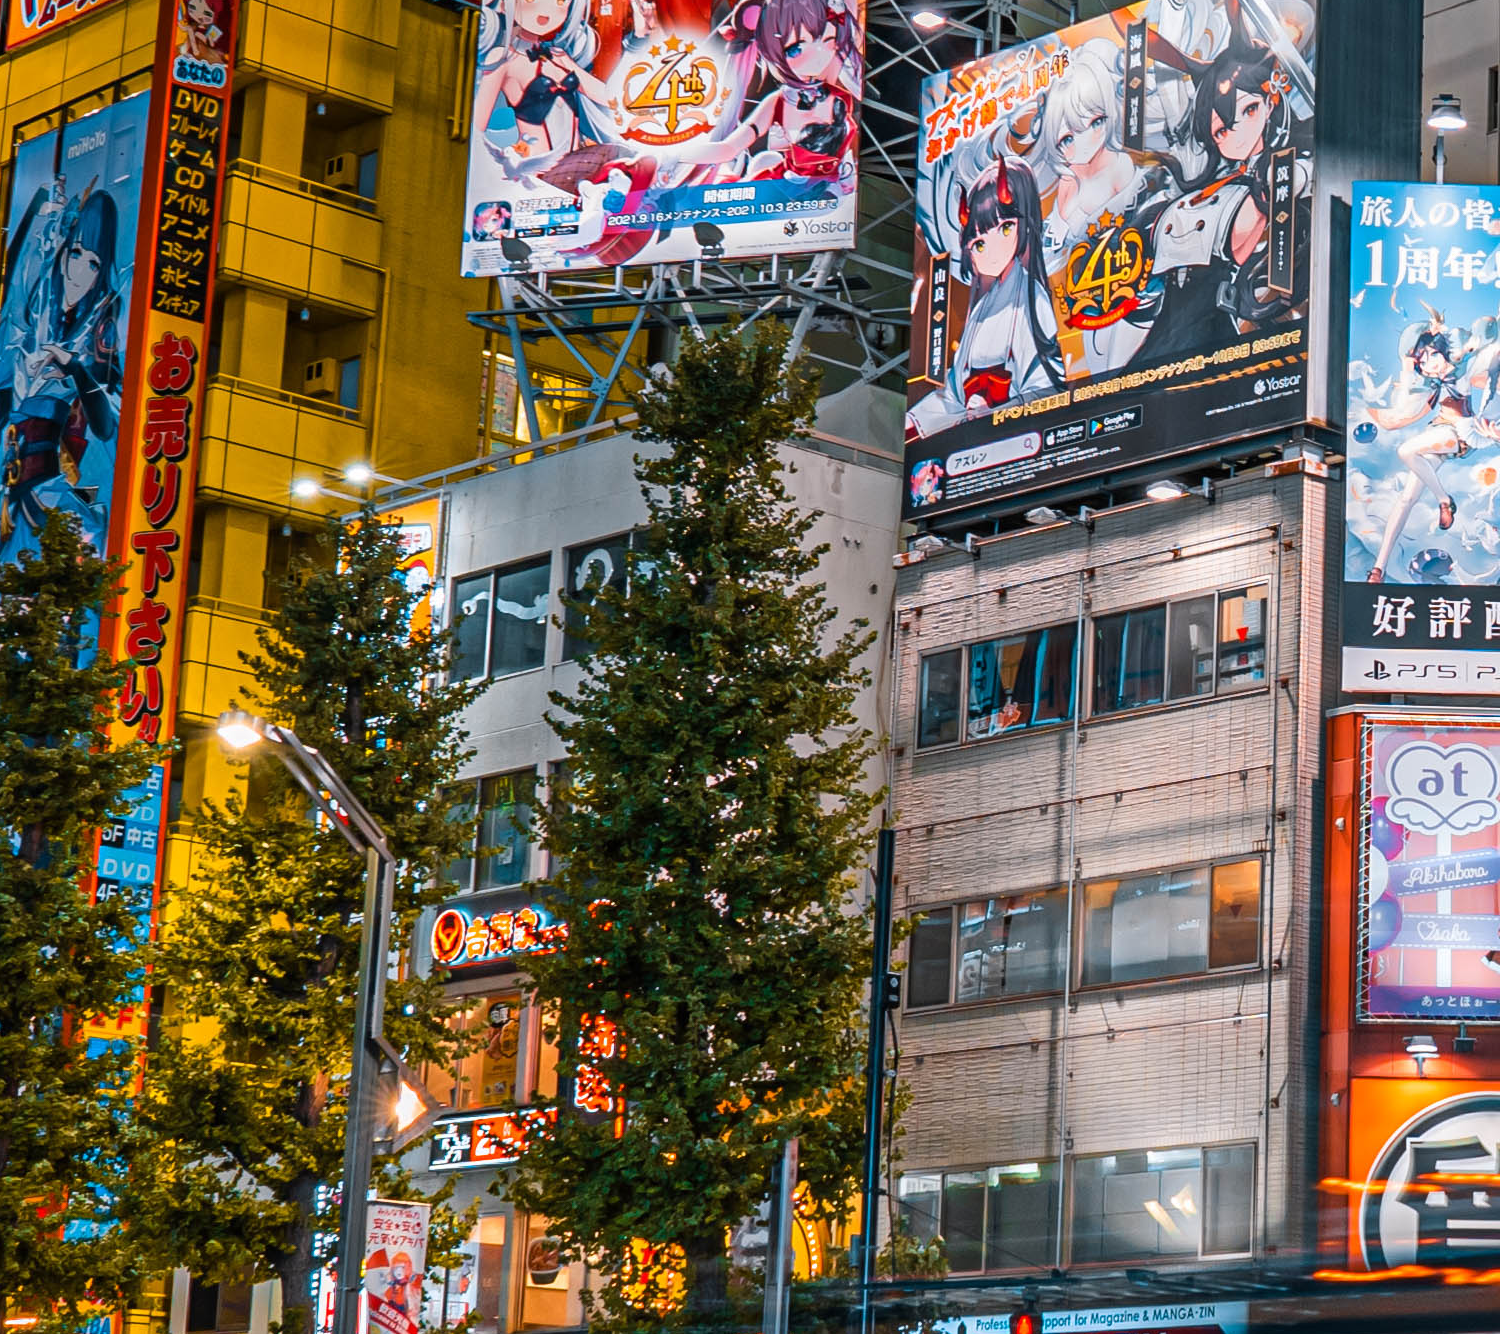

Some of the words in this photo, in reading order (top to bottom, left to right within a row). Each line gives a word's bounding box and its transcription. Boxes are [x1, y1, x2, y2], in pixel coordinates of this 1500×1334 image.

[173, 56, 227, 88] あなたの
[173, 88, 221, 121] DVD
[170, 113, 219, 144] ブルーレイ
[168, 138, 216, 170] ゲーム
[174, 166, 206, 191] CD
[163, 188, 211, 219] アイドル
[703, 185, 756, 204] 開催期間
[160, 212, 208, 242] アニメ
[803, 219, 855, 235] Yostar
[159, 237, 205, 267] コミック
[159, 264, 202, 292] ホビー
[155, 289, 201, 318] フィギュア
[1265, 372, 1302, 392] Yostar
[953, 452, 988, 470] アズレン
[1397, 664, 1457, 679] PS5
[1418, 762, 1471, 799] at
[102, 858, 152, 882] DVD
[464, 906, 539, 960] 吉野家
[1074, 1310, 1087, 1326] for
[1090, 1309, 1140, 1328] Magazine
